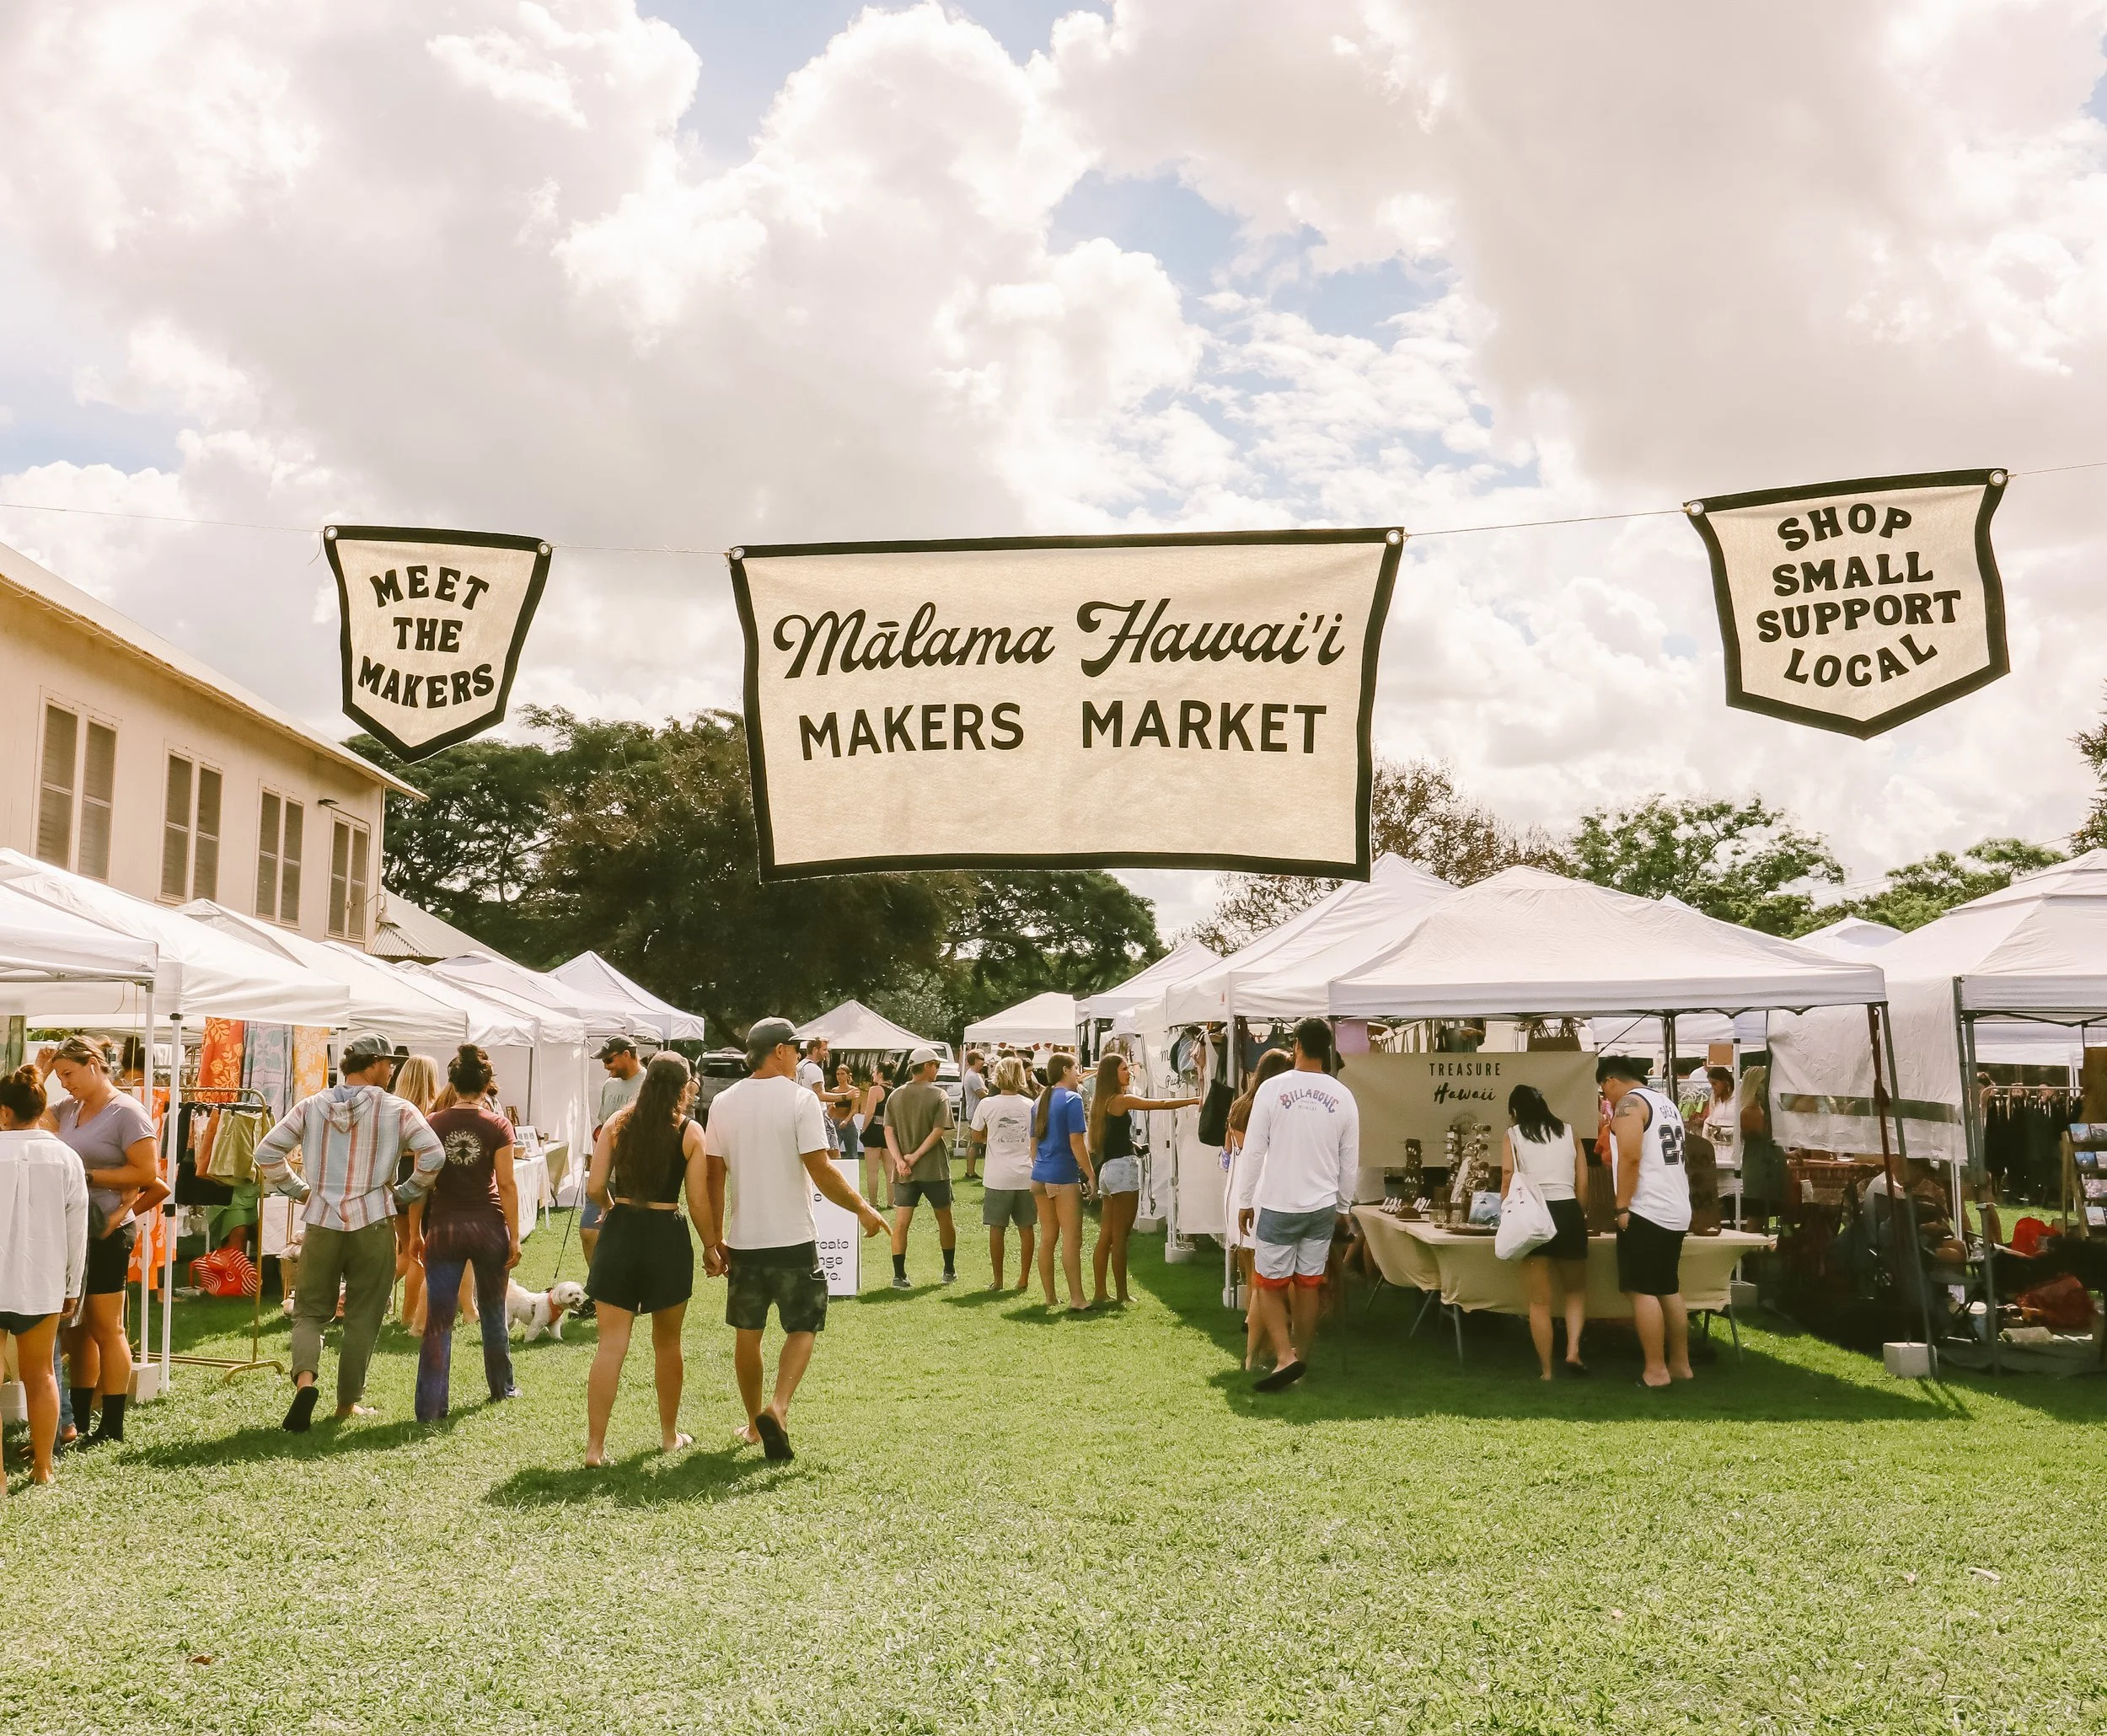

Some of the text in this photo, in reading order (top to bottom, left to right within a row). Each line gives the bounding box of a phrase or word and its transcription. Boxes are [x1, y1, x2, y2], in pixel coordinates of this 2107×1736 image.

[1777, 503, 1911, 551] SHOP
[369, 565, 490, 611] MEET
[1772, 551, 1933, 597] SMALL
[393, 617, 464, 653] THE
[1756, 590, 1961, 642] SUPPORT
[773, 601, 1056, 679] Mālama
[1783, 634, 1938, 688] LOCAL
[357, 656, 496, 709] MAKERS
[798, 699, 1327, 761] MAKERS MARKET
[1429, 1063, 1500, 1076] TREASURE
[1279, 1088, 1339, 1113] BILLABONG
[1434, 1082, 1496, 1105] Hawaii
